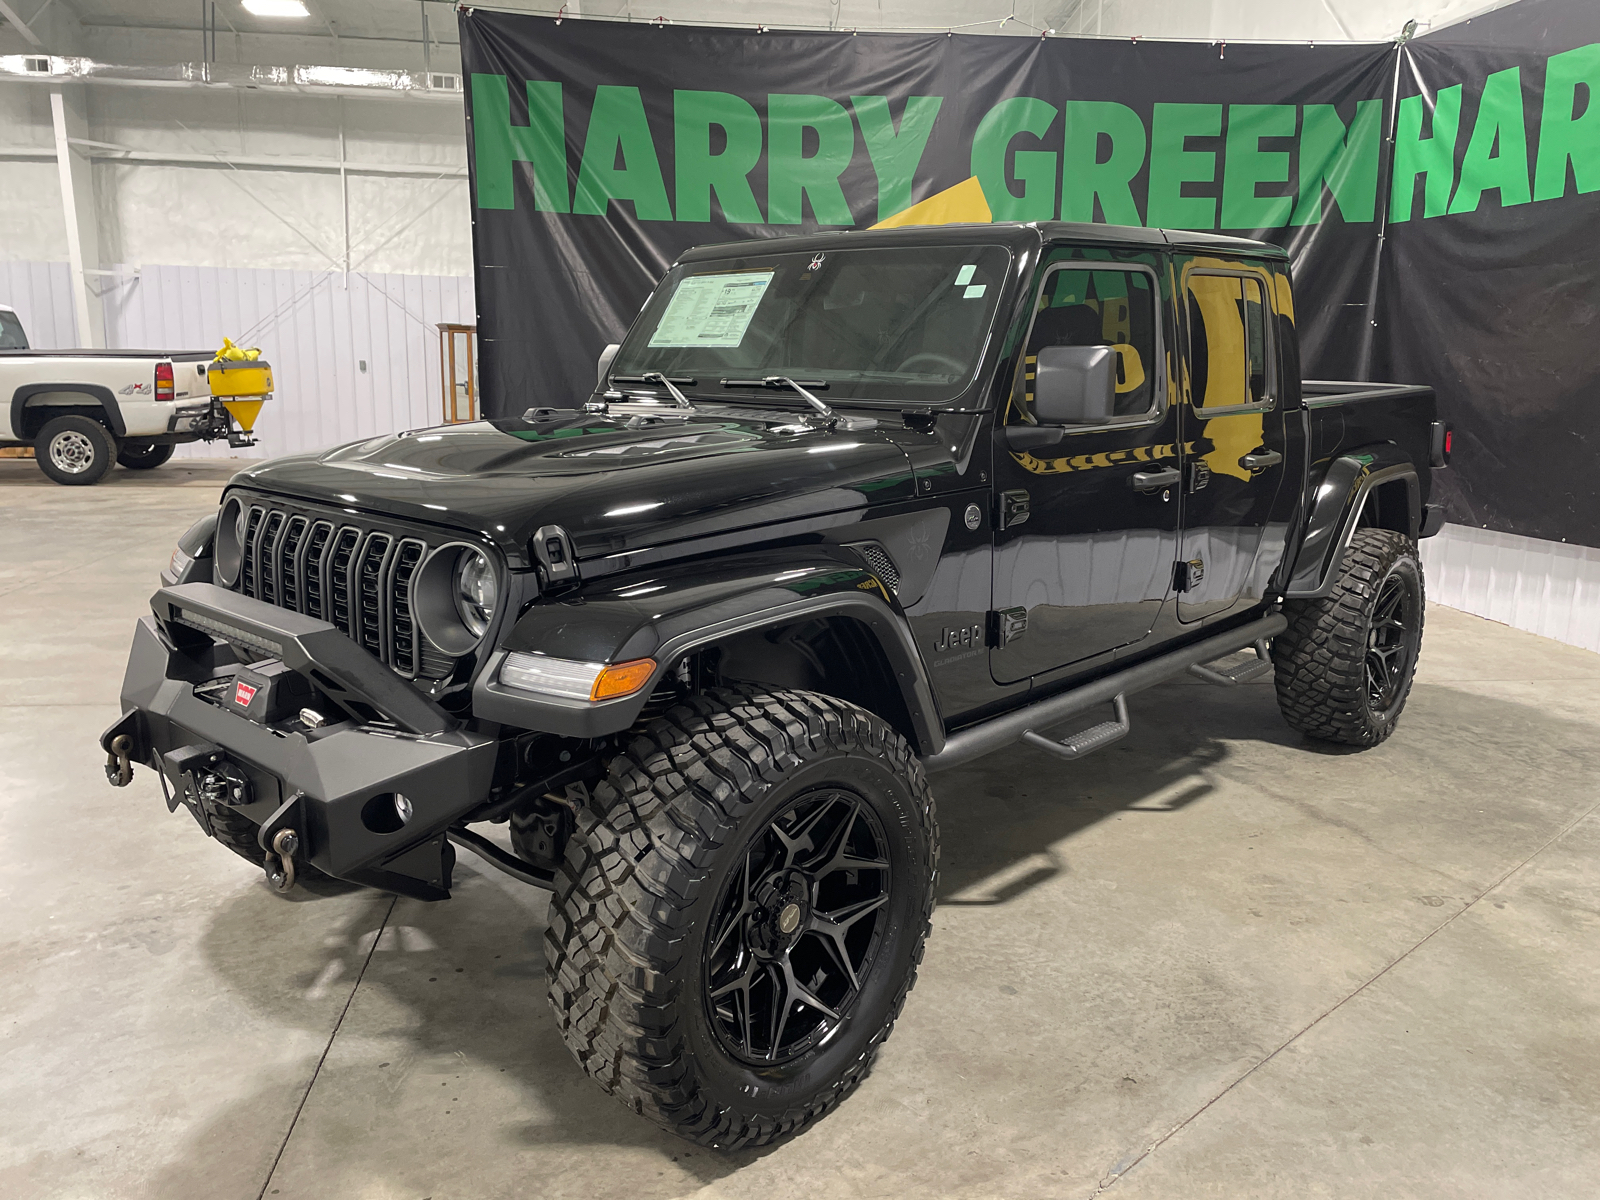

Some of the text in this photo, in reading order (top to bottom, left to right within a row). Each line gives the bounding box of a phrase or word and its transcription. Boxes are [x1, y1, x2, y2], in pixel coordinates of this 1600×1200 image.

[471, 73, 1383, 230] HARRY GREEN
[1388, 42, 1600, 224] HAR
[934, 624, 981, 652] Jeep
